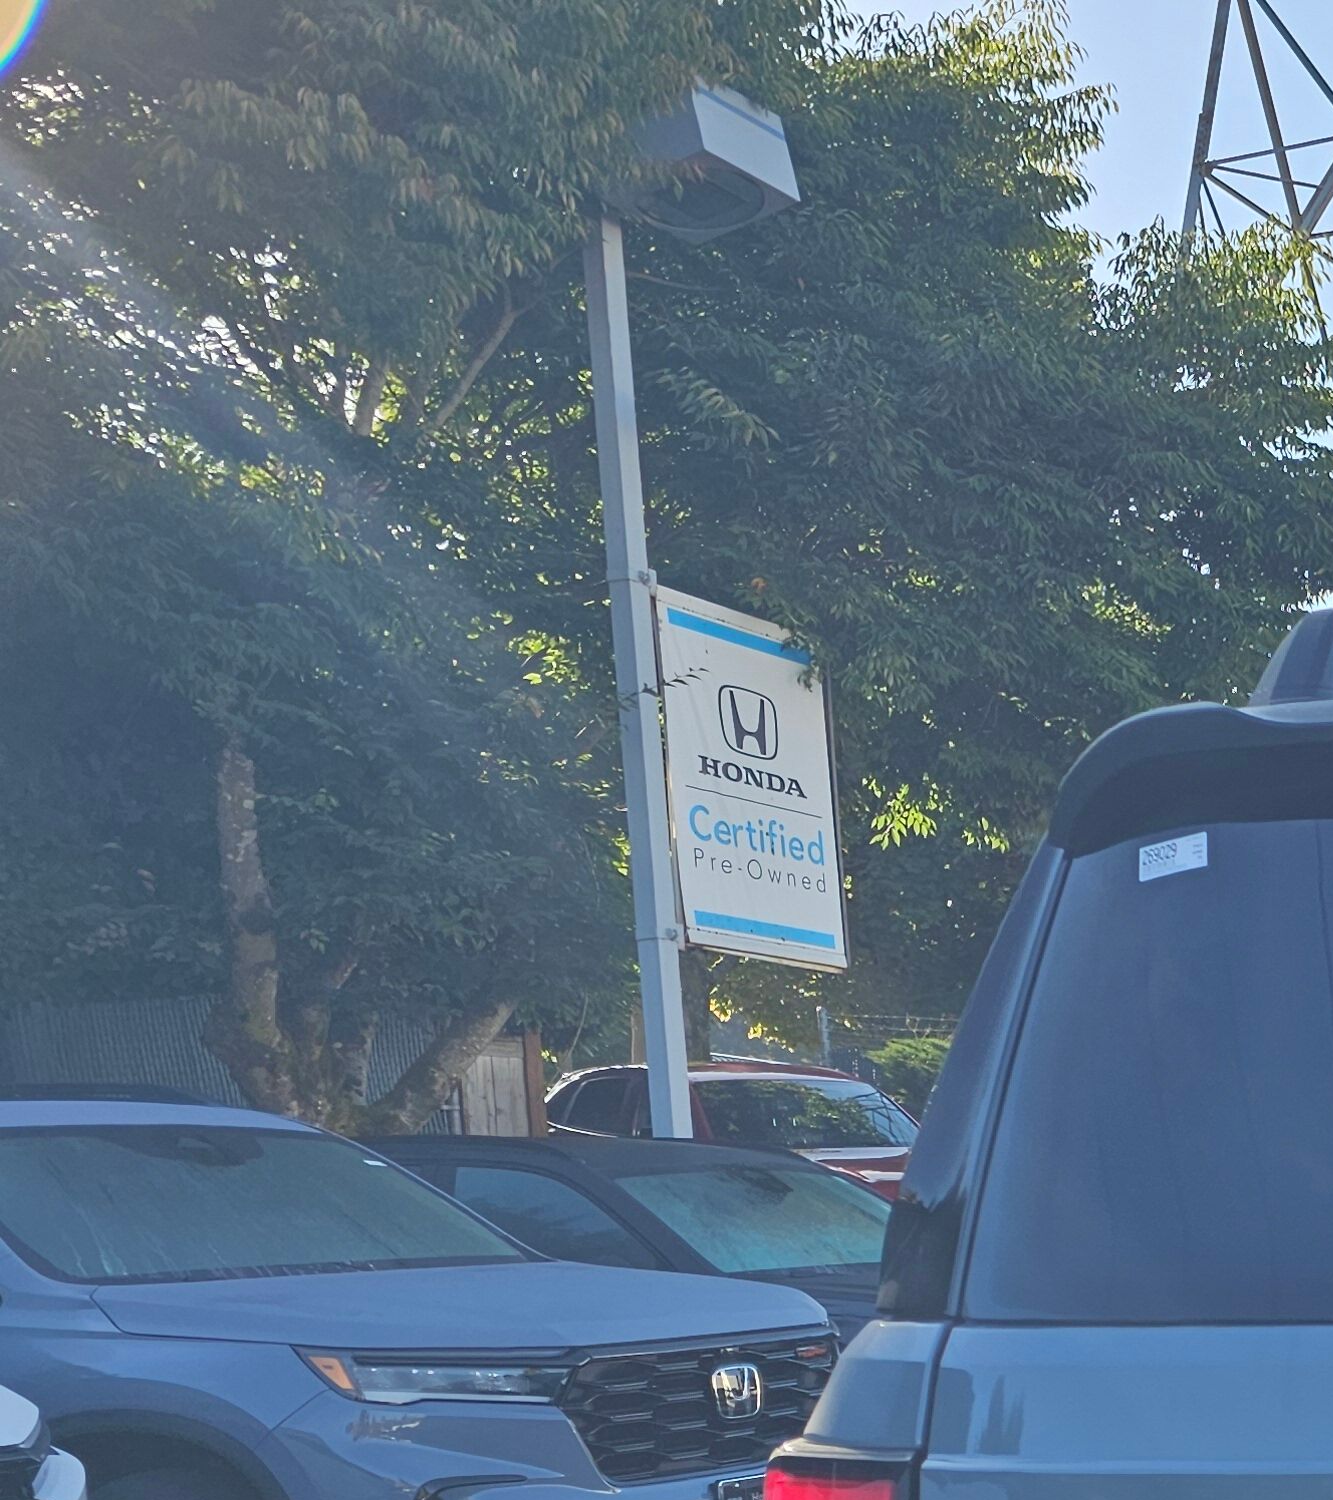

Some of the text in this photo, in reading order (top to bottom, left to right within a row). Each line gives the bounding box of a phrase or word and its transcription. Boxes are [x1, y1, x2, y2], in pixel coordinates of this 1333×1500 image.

[698, 754, 808, 800] HONDA
[689, 804, 825, 867] Certified
[694, 848, 826, 893] Pre-Owned
